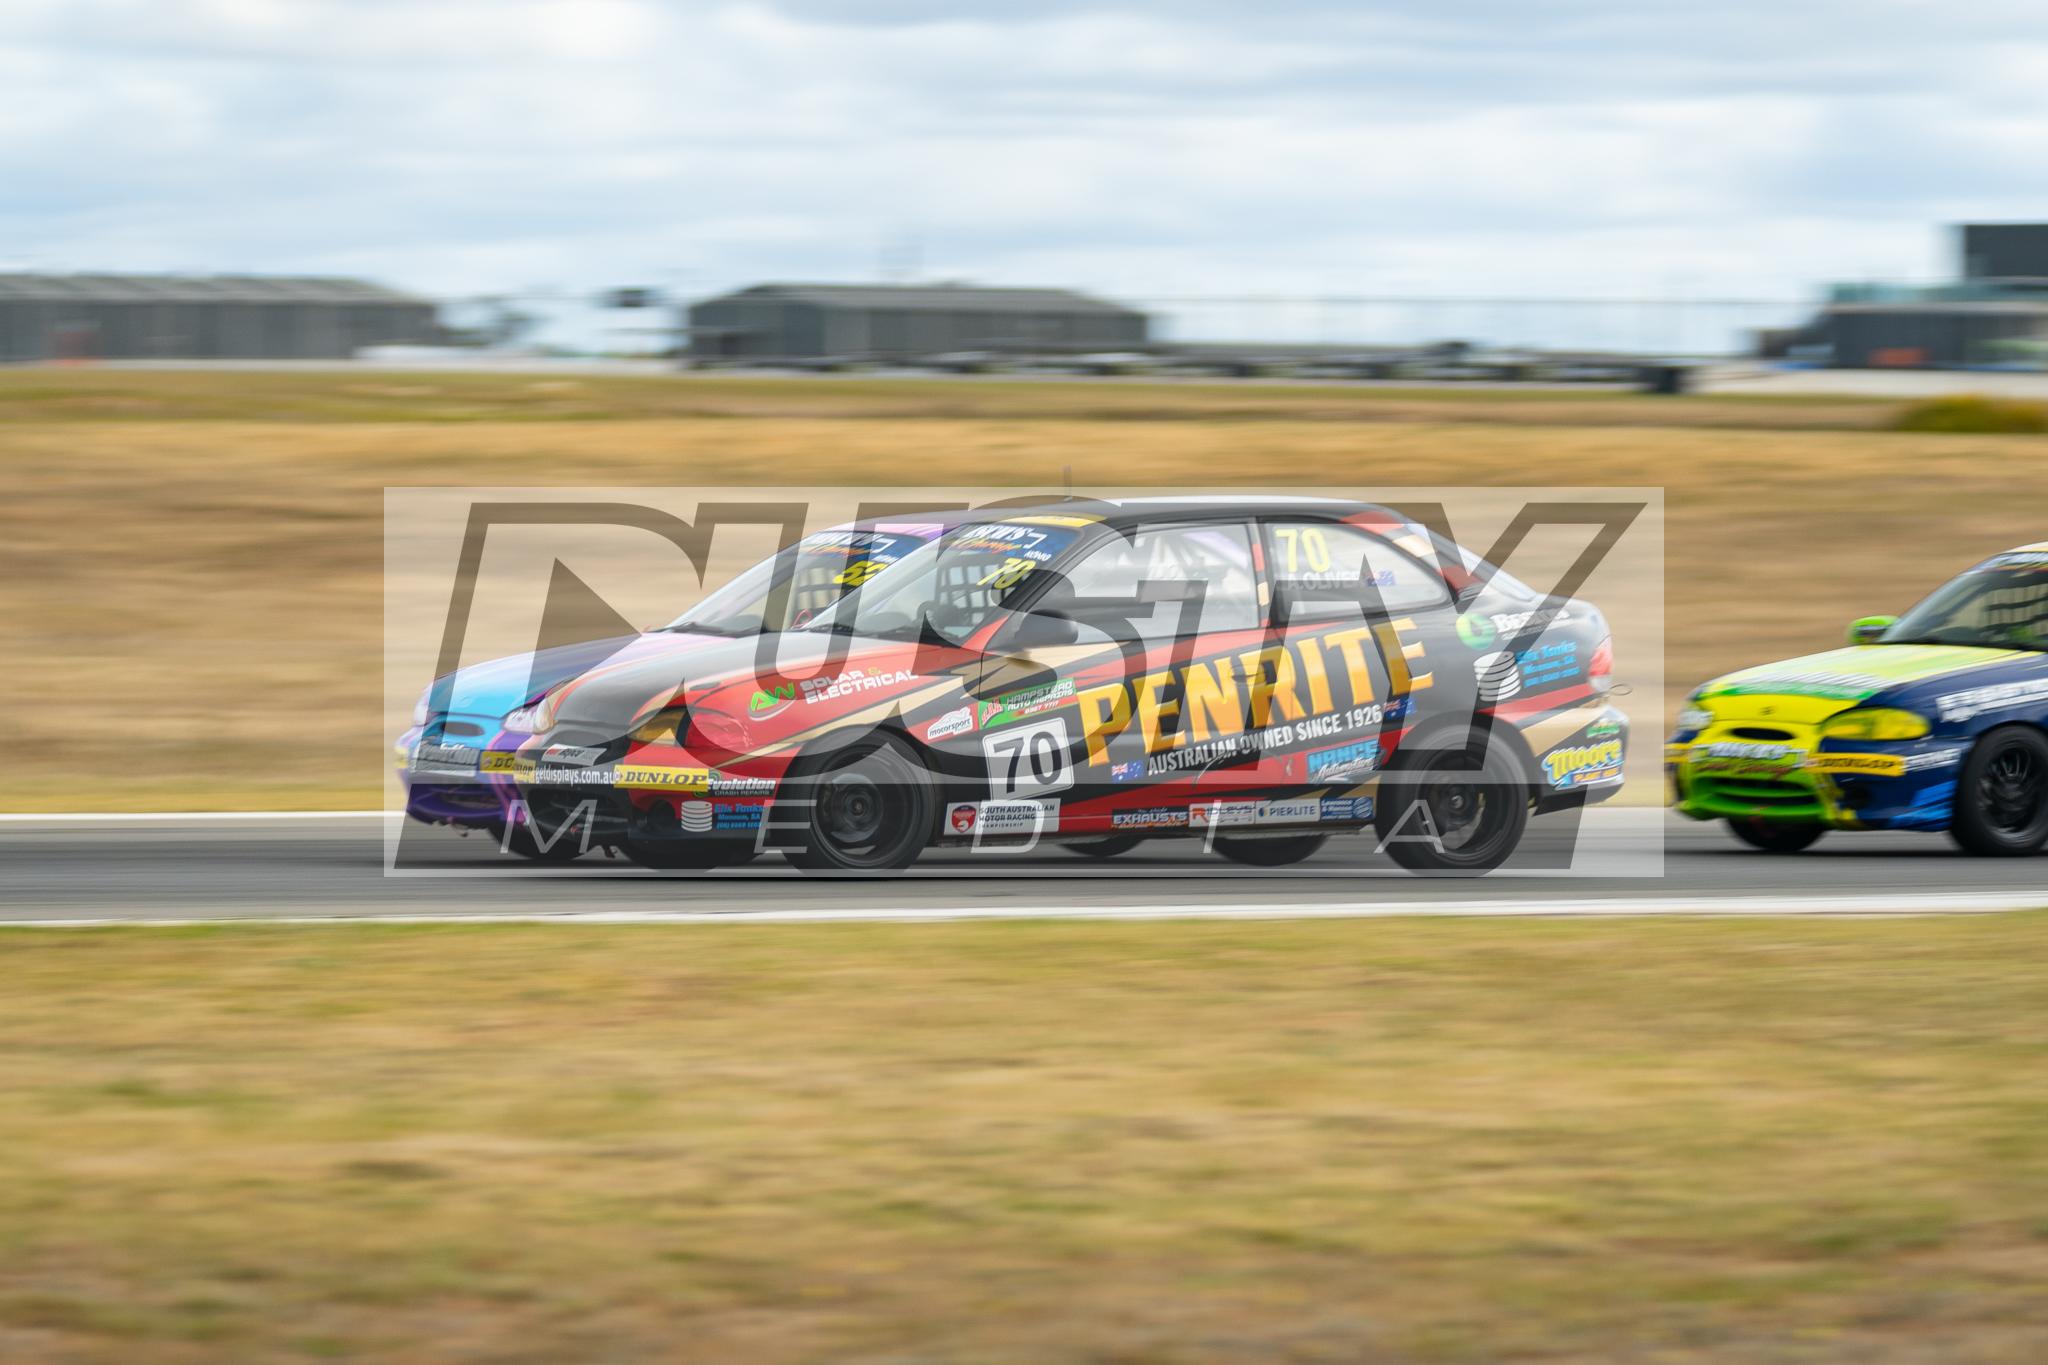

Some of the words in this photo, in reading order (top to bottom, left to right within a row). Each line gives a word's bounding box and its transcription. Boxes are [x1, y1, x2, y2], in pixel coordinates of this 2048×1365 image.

[1275, 528, 1330, 573] 70
[976, 557, 1036, 589] 70
[800, 670, 865, 692] SOLAR
[804, 669, 920, 705] ELECTRICAL
[1076, 617, 1434, 768] PENRITE
[1148, 734, 1237, 776] AUSTRALIAN
[1241, 725, 1293, 757] OWNED
[1296, 715, 1341, 742] SINCE
[1345, 705, 1383, 732] 1926
[993, 731, 1062, 794] 70
[626, 771, 708, 785] DUNLOP
[979, 814, 1005, 822] MOTOR
[1006, 813, 1035, 822] RACING
[980, 806, 1005, 815] SOUTH
[1007, 804, 1054, 814] AUSTRALIAN
[1113, 811, 1188, 825] EXHAUSTS
[1269, 806, 1316, 817] PIERLITE
